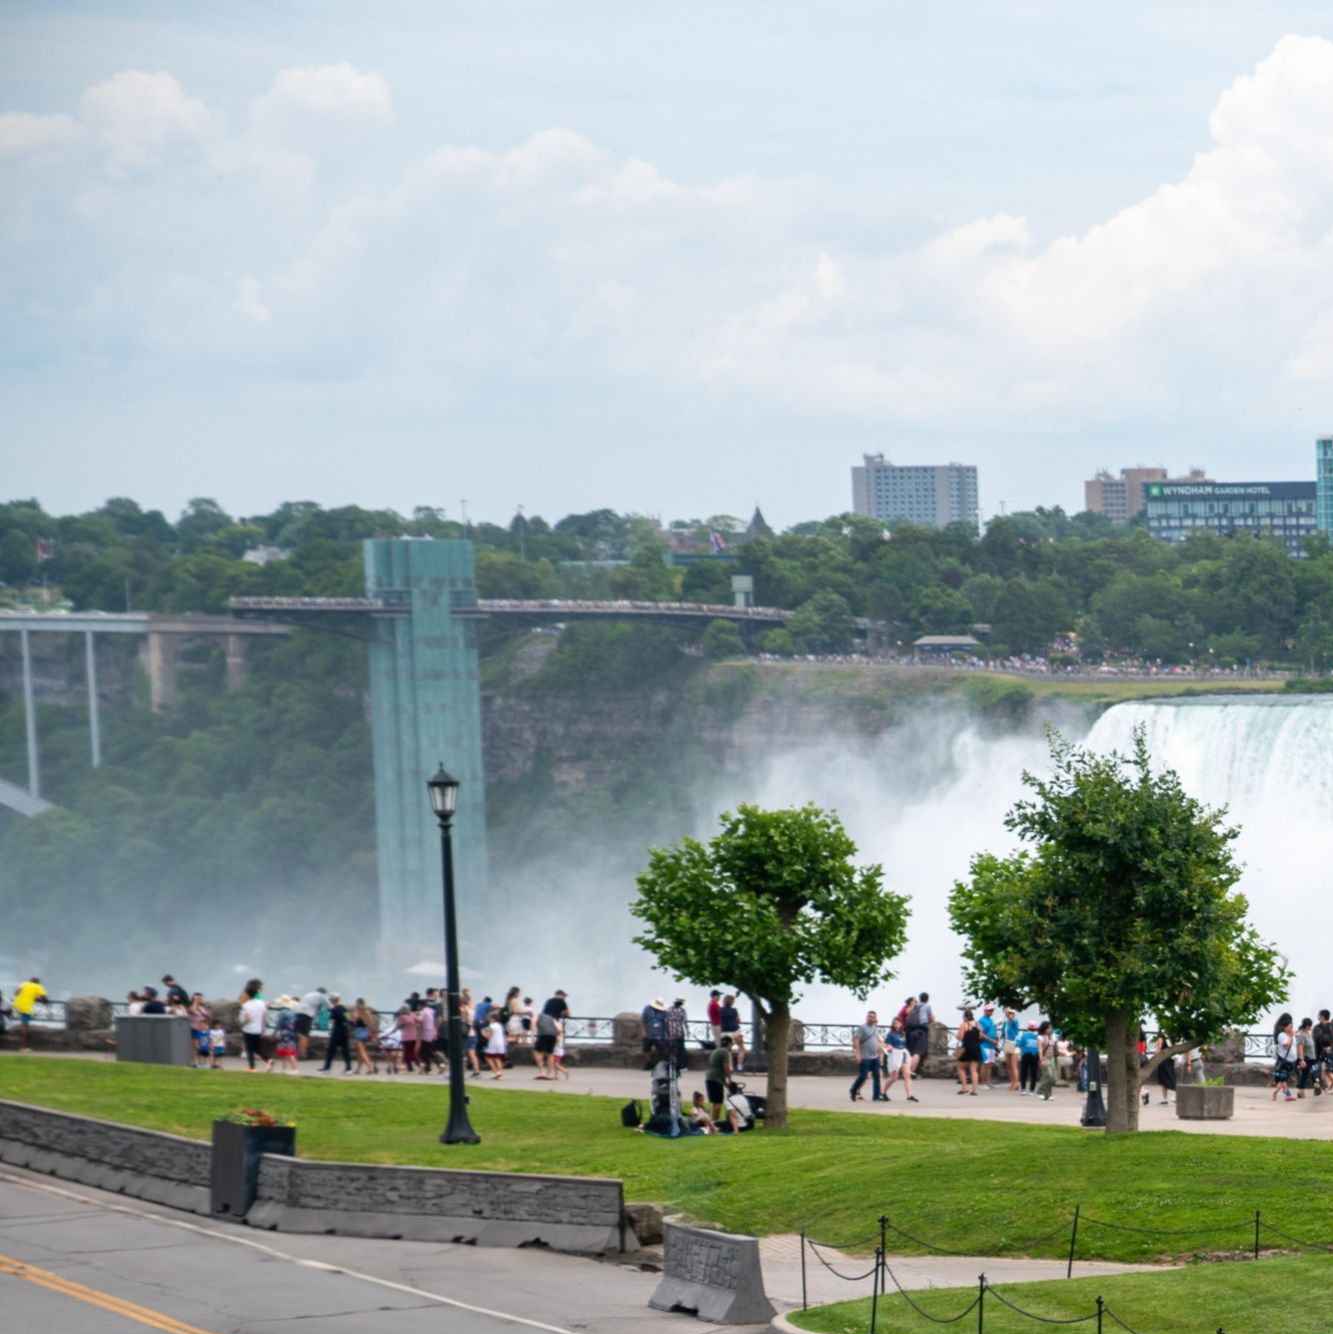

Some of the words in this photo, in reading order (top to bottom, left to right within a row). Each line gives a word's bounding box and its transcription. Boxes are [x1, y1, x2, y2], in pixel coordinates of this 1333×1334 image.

[1162, 486, 1213, 495] WYNDHAM
[1214, 487, 1245, 495] GARDEN
[1246, 487, 1271, 495] HOTEL
